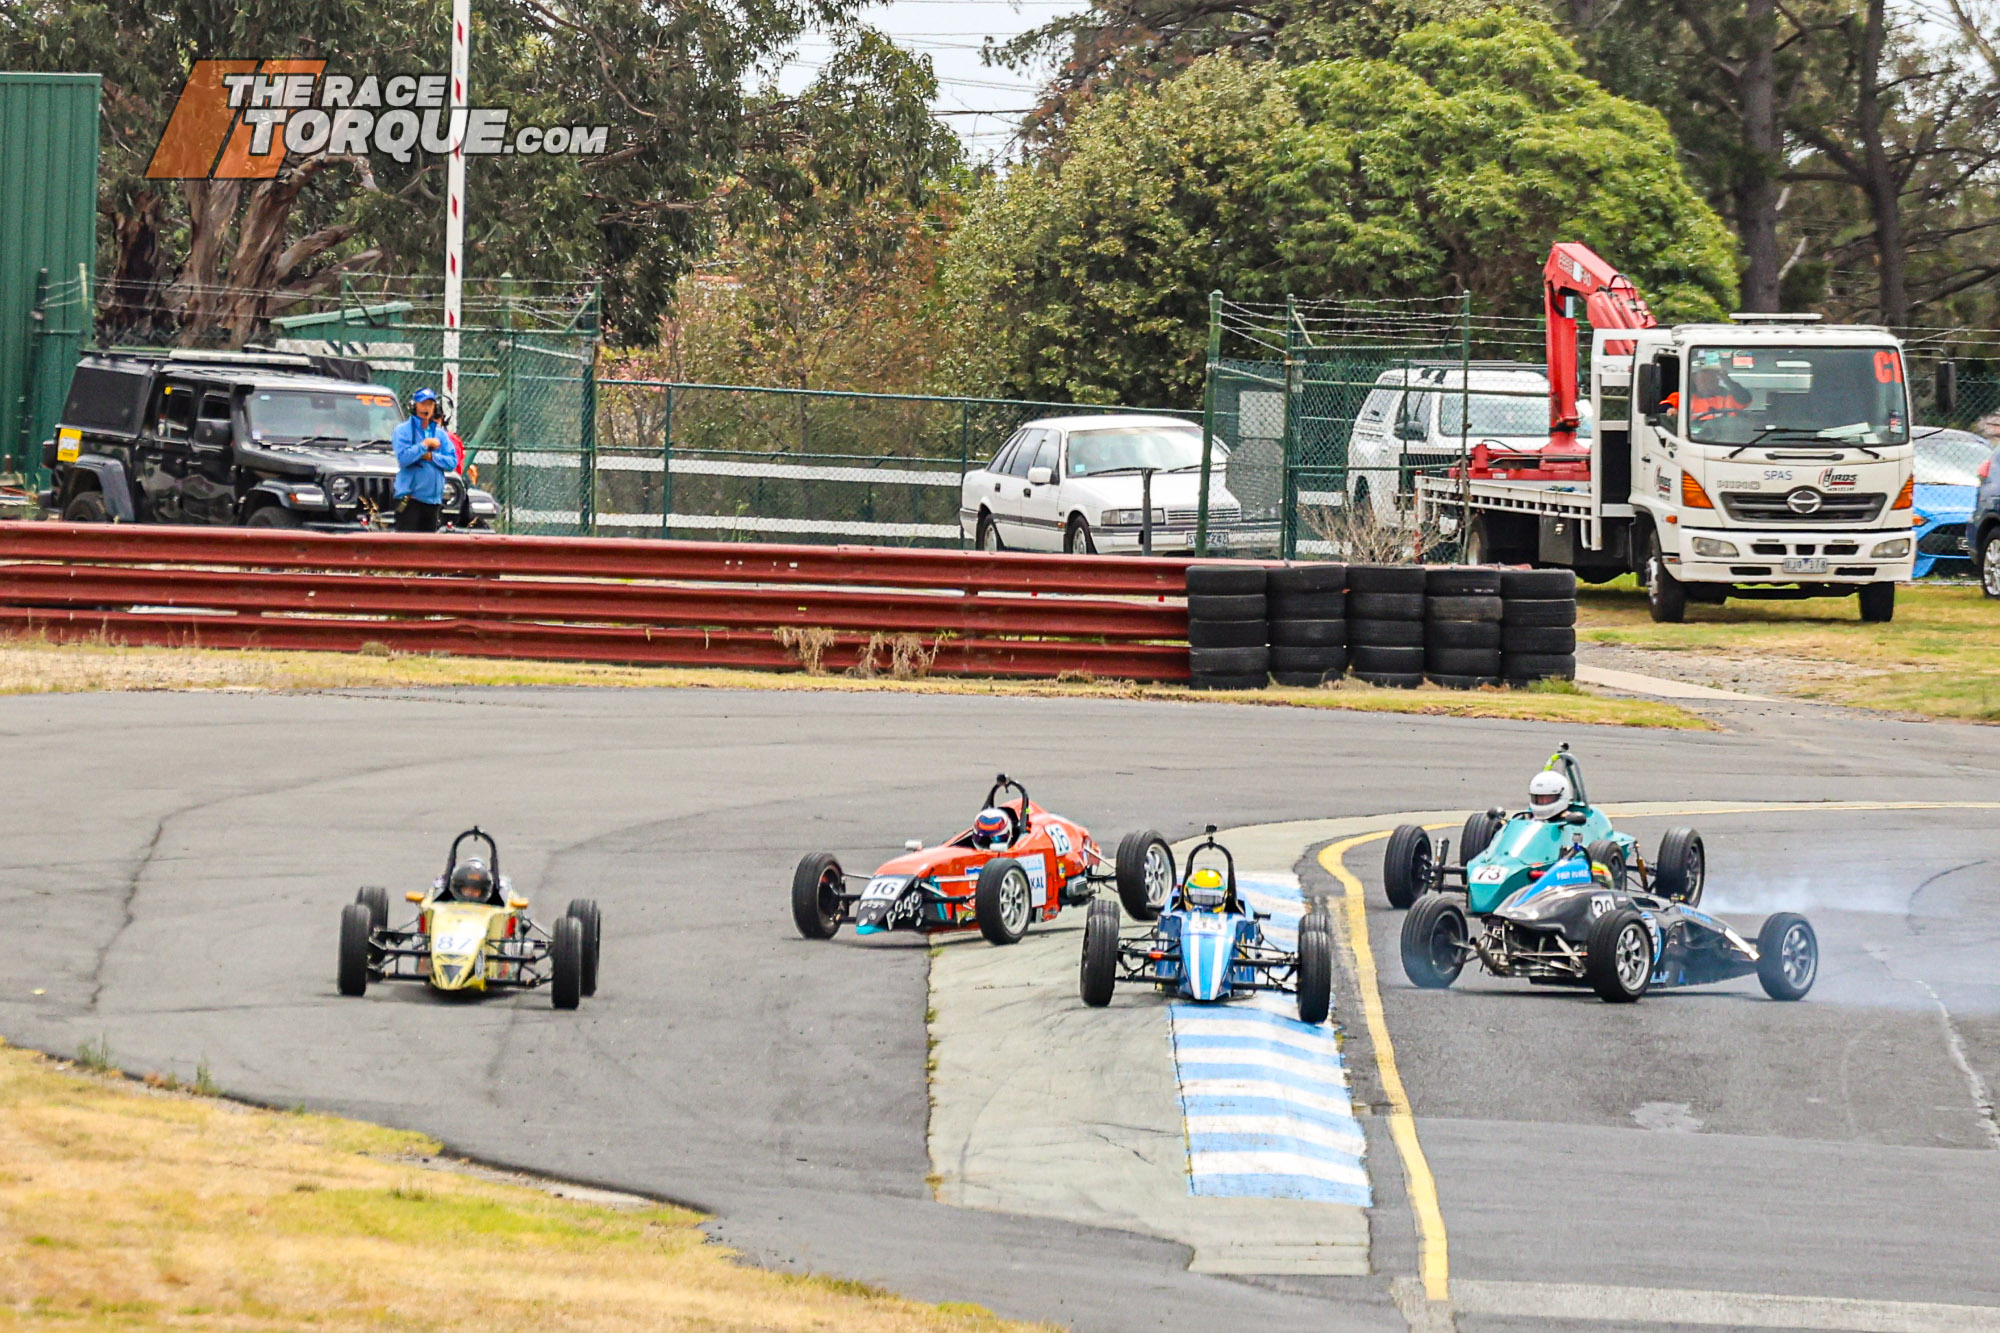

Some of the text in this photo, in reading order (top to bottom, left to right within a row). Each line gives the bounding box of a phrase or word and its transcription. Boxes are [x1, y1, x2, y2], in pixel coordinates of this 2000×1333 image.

[355, 394, 393, 408] TC
[1763, 470, 1793, 481] SPAS
[1716, 479, 1761, 490] HINO
[1049, 827, 1070, 852] 16
[1476, 865, 1502, 881] 73
[872, 881, 899, 896] 16
[437, 936, 473, 950] 87
